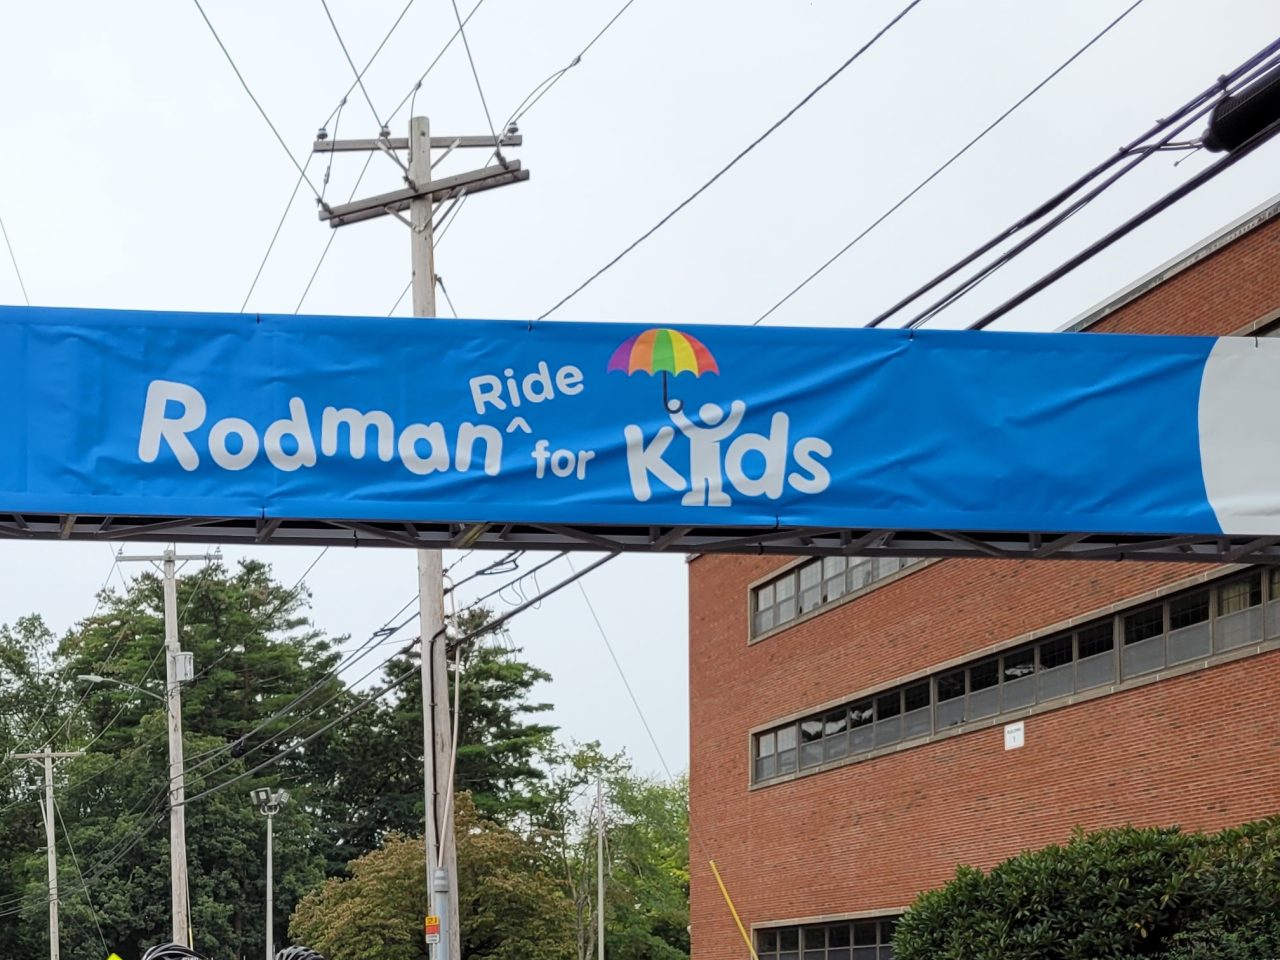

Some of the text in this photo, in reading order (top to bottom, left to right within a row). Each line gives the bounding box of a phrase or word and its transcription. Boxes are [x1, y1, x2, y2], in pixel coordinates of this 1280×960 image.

[469, 361, 585, 415] Ride
[138, 380, 832, 507] Rodman for Kids
